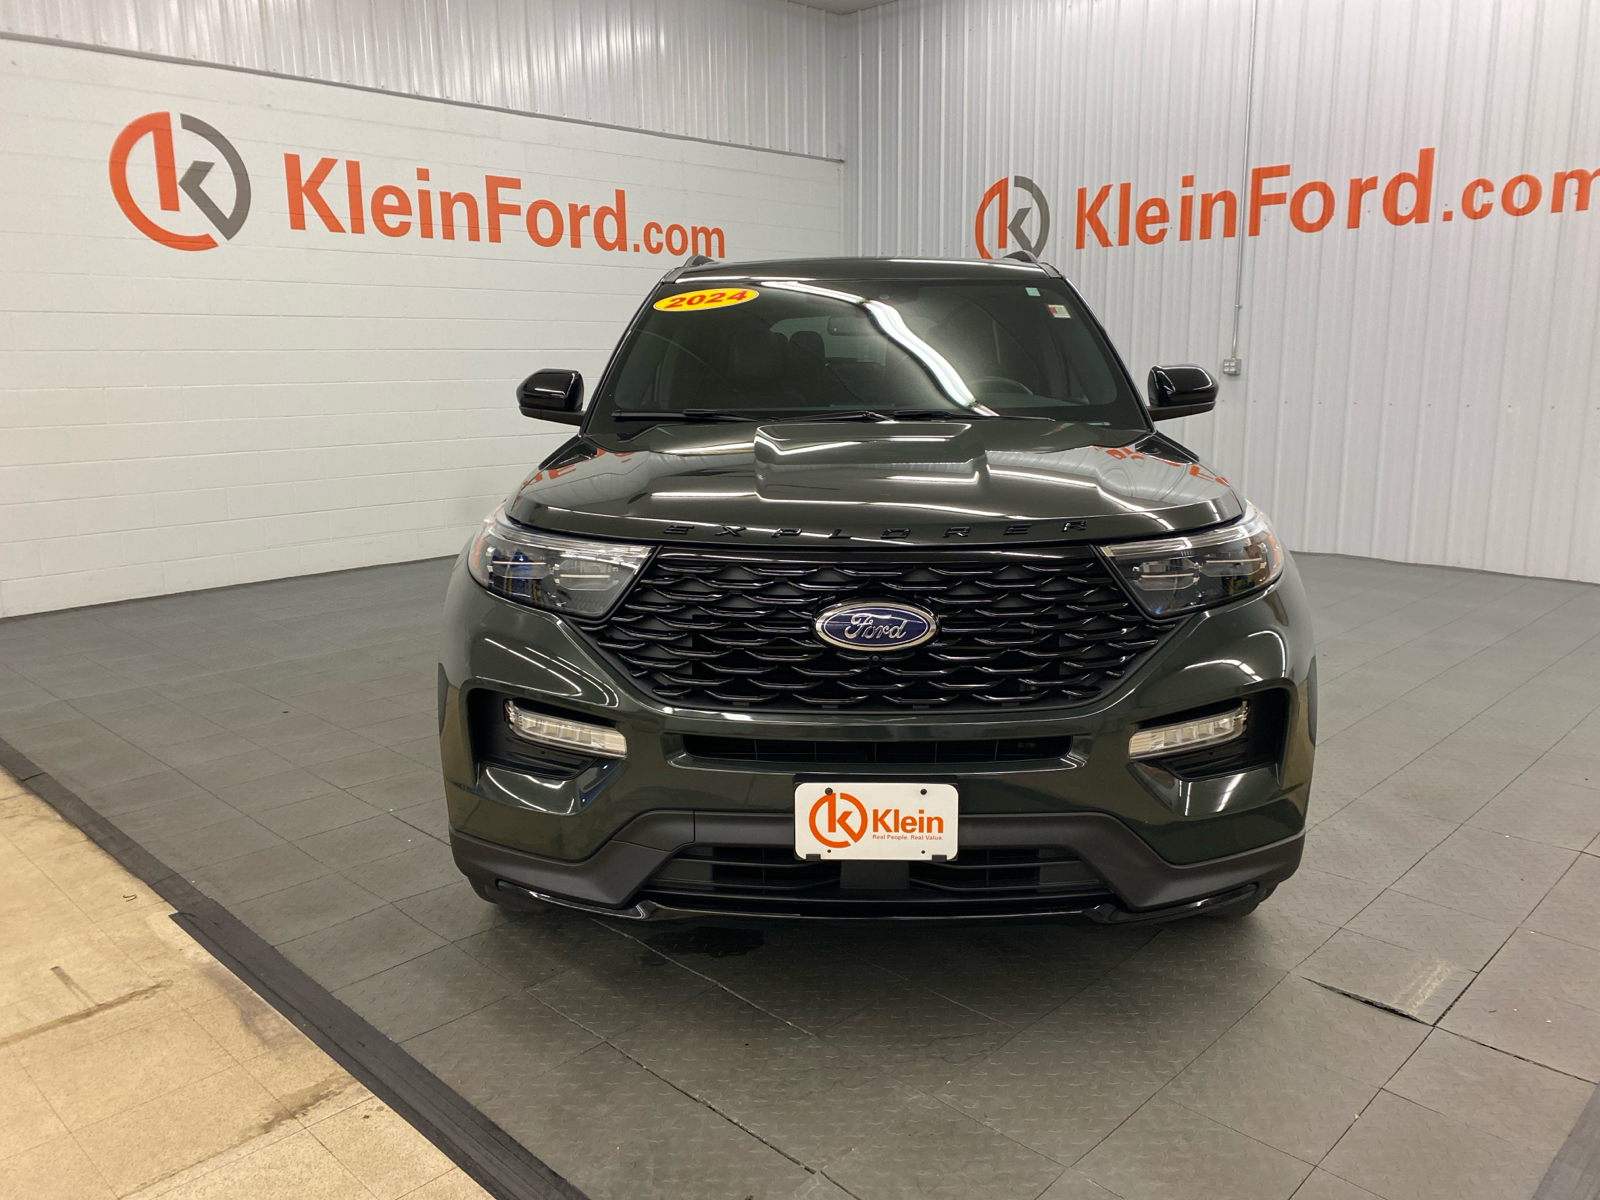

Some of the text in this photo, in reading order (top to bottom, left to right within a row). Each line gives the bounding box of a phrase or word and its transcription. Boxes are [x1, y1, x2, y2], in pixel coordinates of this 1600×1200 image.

[284, 153, 725, 259] KleinFord.com
[1075, 147, 1600, 250] KleinFord.com
[664, 290, 748, 309] 2024
[663, 519, 1087, 540] EXPLORER
[842, 612, 910, 639] Ford
[872, 809, 944, 833] Klein
